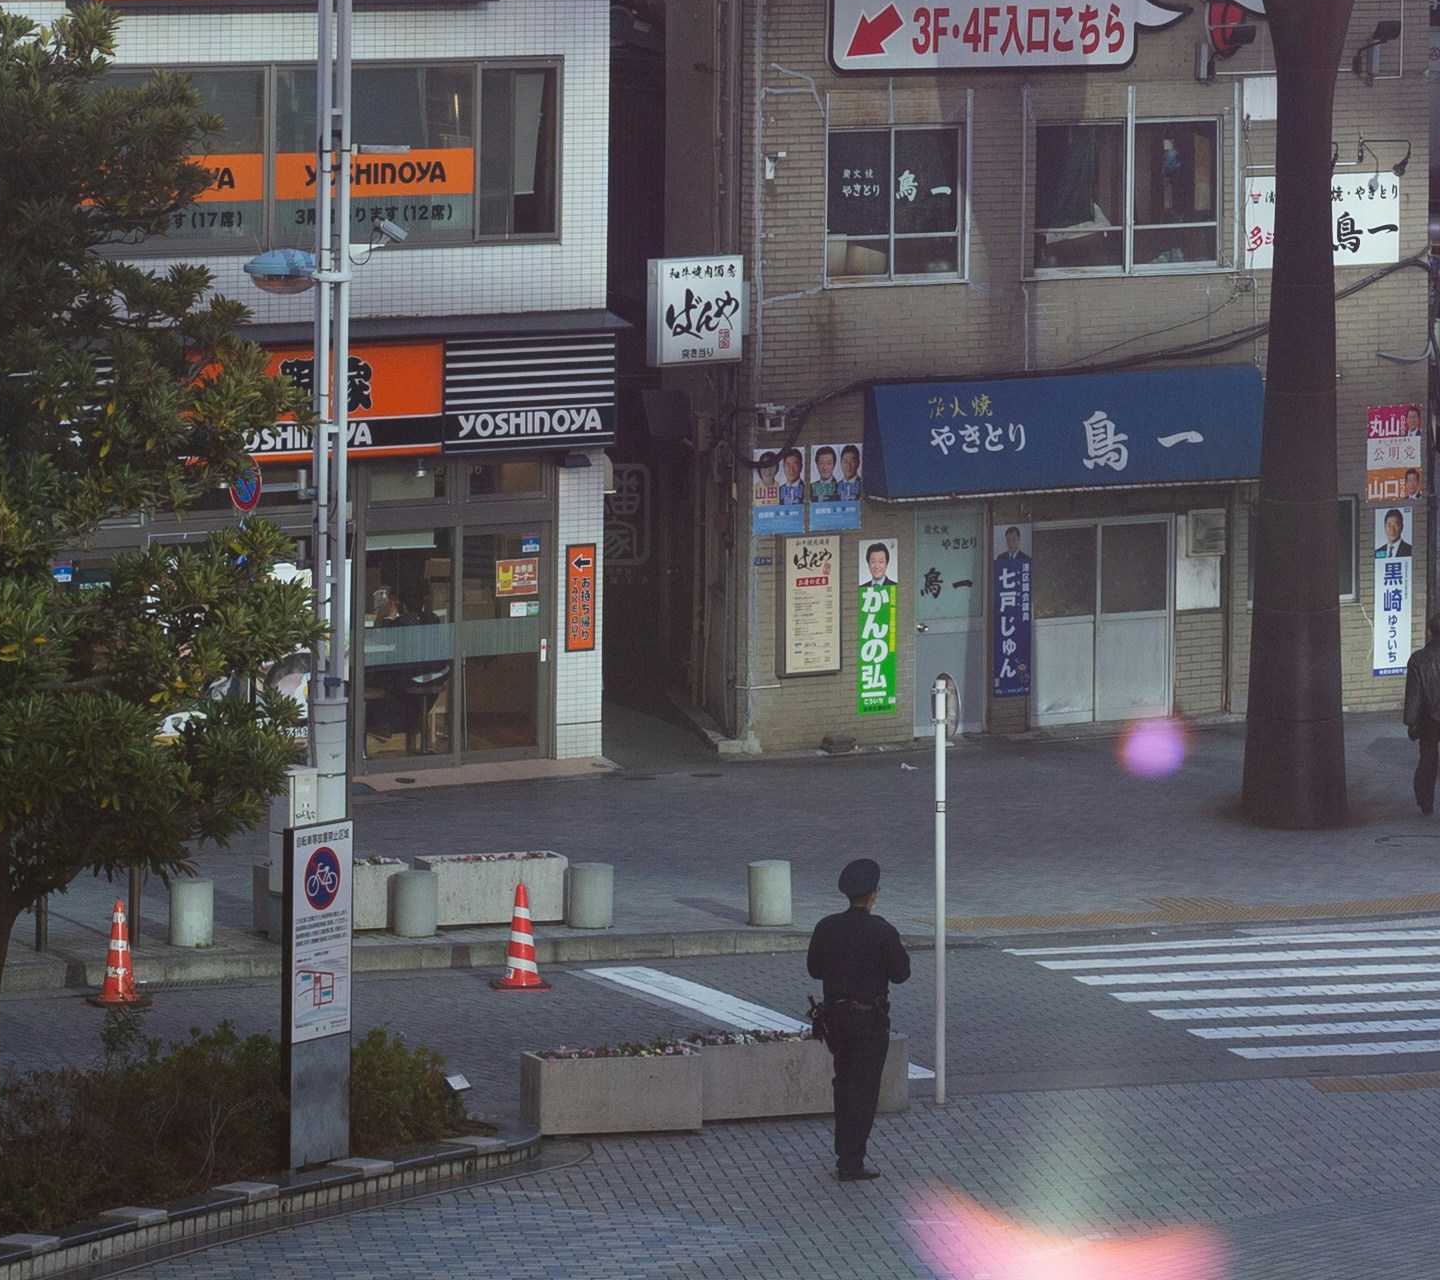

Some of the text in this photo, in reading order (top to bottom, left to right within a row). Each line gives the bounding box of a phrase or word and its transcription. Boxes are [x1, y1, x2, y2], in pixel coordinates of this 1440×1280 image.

[841, 183, 881, 198] やきとり
[458, 407, 603, 438] YOSHINOYA
[1369, 416, 1400, 437] 丸山
[929, 423, 1027, 455] やきとり
[1082, 410, 1205, 471] 鳥一
[1373, 444, 1416, 461] 公明党
[1368, 479, 1399, 500] 山口
[580, 577, 592, 642] お持ち帰り
[998, 567, 1018, 679] 七戸じゅん
[861, 586, 890, 699] かんの弘一
